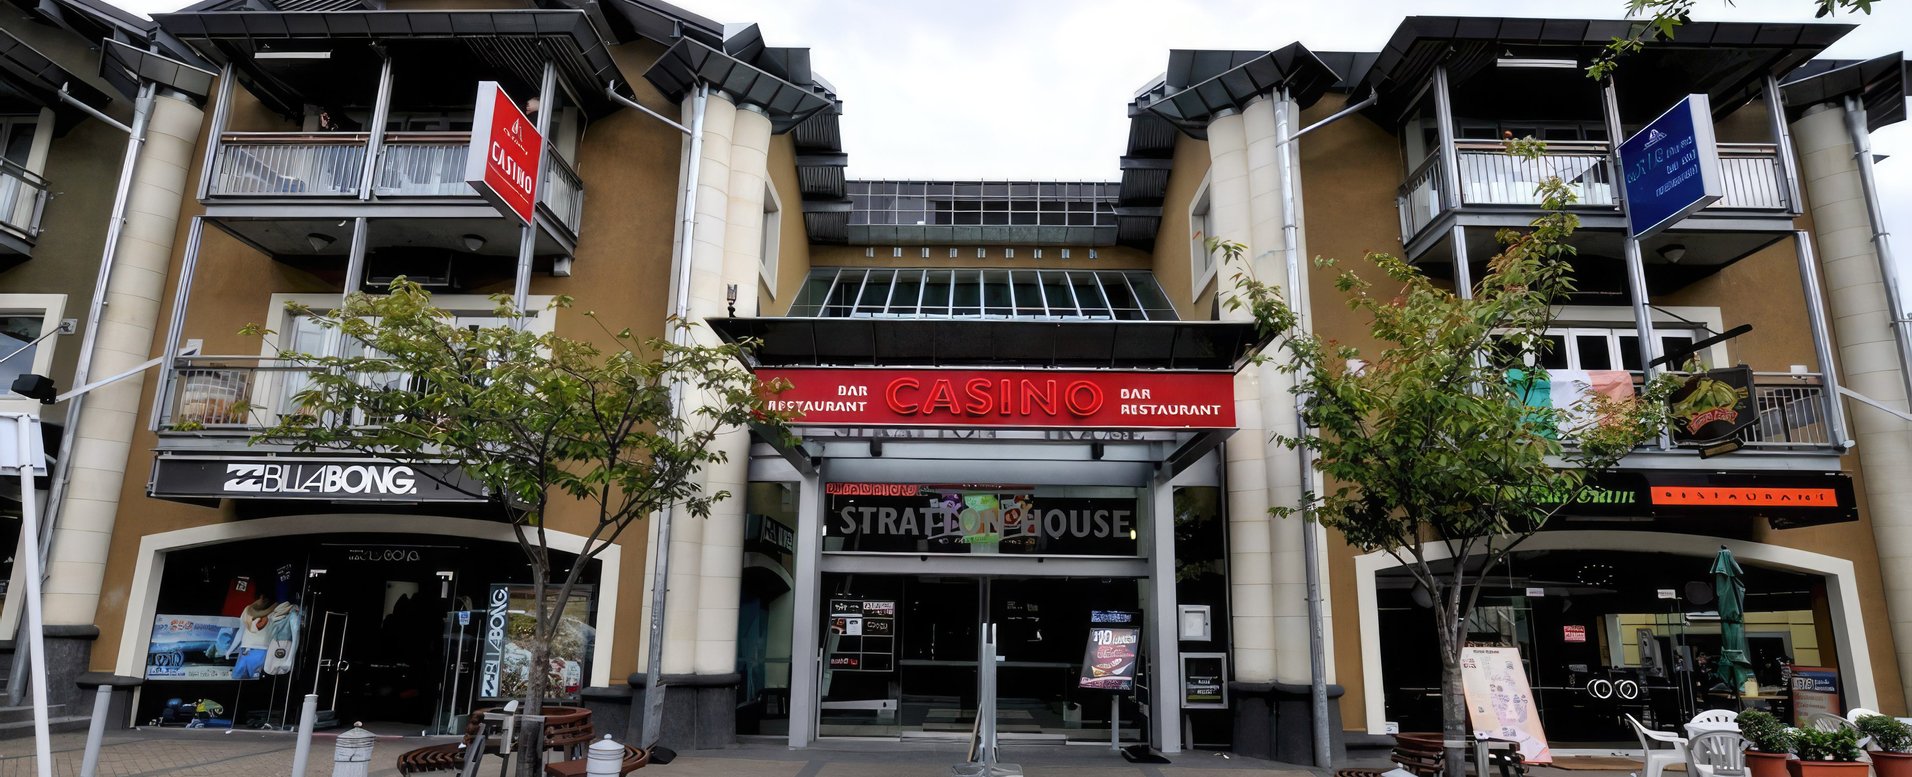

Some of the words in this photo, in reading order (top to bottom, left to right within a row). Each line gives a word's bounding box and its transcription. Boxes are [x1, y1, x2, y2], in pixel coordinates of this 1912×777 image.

[491, 140, 532, 195] CASINO
[838, 385, 868, 396] BAR
[884, 377, 1105, 417] CASINO
[1120, 388, 1151, 399] BAR
[1120, 404, 1221, 415] RESTAURANT
[840, 506, 1004, 536] STRATTON
[1020, 508, 1131, 539] HOUSE
